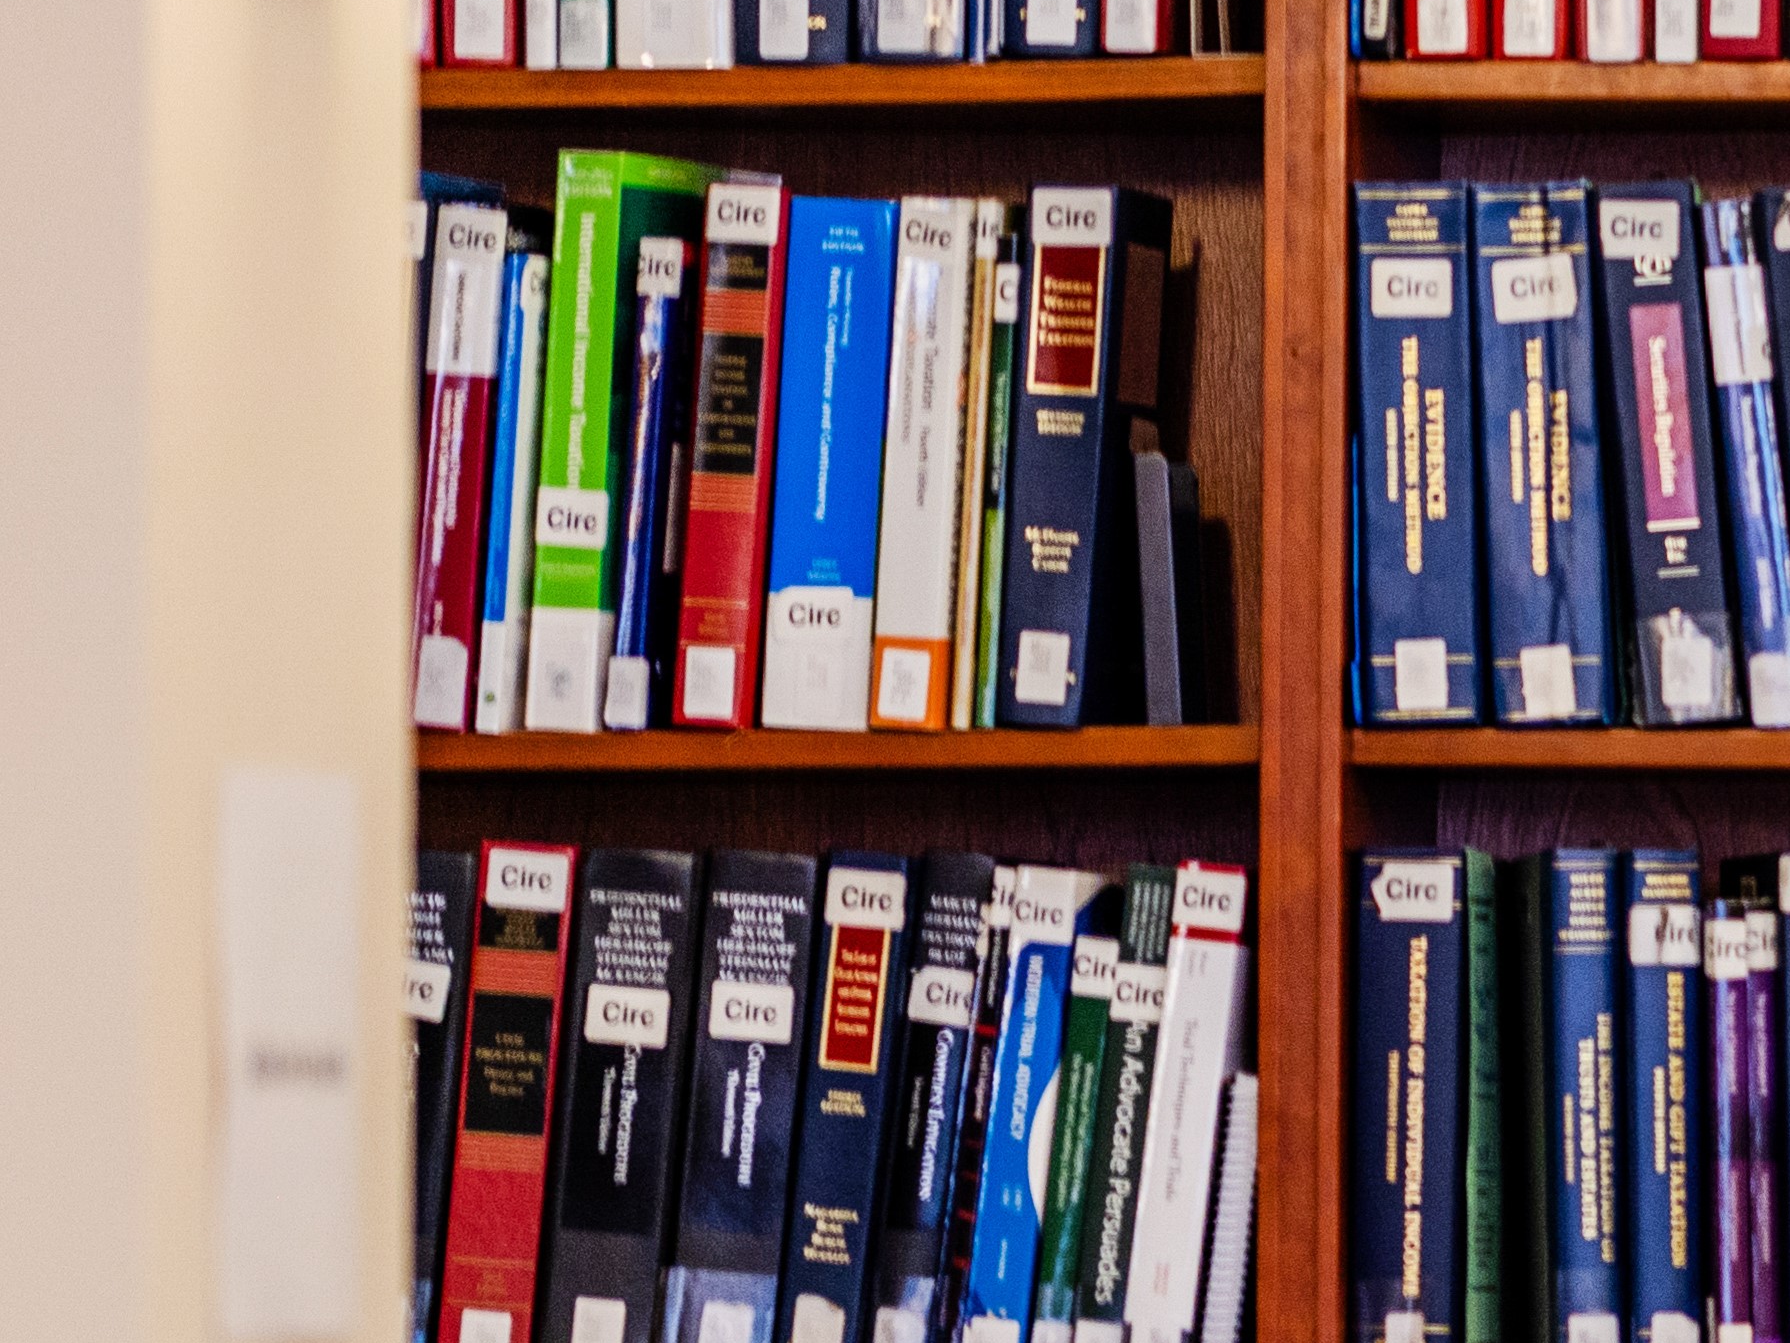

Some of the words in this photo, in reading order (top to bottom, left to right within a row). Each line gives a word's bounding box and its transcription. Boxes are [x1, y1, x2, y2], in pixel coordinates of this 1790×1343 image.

[717, 200, 767, 228] Circ
[1046, 204, 1096, 230] Circ
[1610, 217, 1662, 239] Circ
[450, 224, 498, 250] Circ
[906, 224, 952, 248] Circ
[573, 212, 597, 335] International
[1387, 275, 1438, 299] Circ
[1510, 275, 1559, 299] Circ
[571, 339, 591, 407] Income
[1426, 388, 1446, 520] EVIDENCE
[546, 508, 599, 535] Circ
[788, 602, 841, 629] Circ
[501, 865, 553, 892] Circ
[1386, 879, 1437, 900] Circ
[841, 887, 891, 912] Circ
[1015, 899, 1063, 924] Circ
[1182, 886, 1231, 912] Circ
[1116, 982, 1163, 1007] Circ
[1406, 936, 1429, 1043] TAXATION
[602, 1000, 654, 1027] Circ
[725, 997, 777, 1023] Circ
[1665, 972, 1686, 1051] ESTATE
[928, 1028, 955, 1105] COMPLEX
[1406, 1044, 1426, 1076] OF
[1668, 1054, 1685, 1101] AND
[1108, 1055, 1148, 1176] Advocate
[1669, 1105, 1686, 1154] GIFT
[613, 1088, 639, 1185] PROCEDURE
[737, 1088, 762, 1187] PROCEDURE
[1402, 1078, 1426, 1209] INDIVIDUAL
[1580, 1113, 1597, 1156] AND
[918, 1107, 945, 1201] LITIGATION
[1580, 1157, 1599, 1241] ESTATES
[1667, 1161, 1688, 1269] TAXATION
[1091, 1177, 1131, 1307] Persuades
[1401, 1210, 1423, 1298] INCOME
